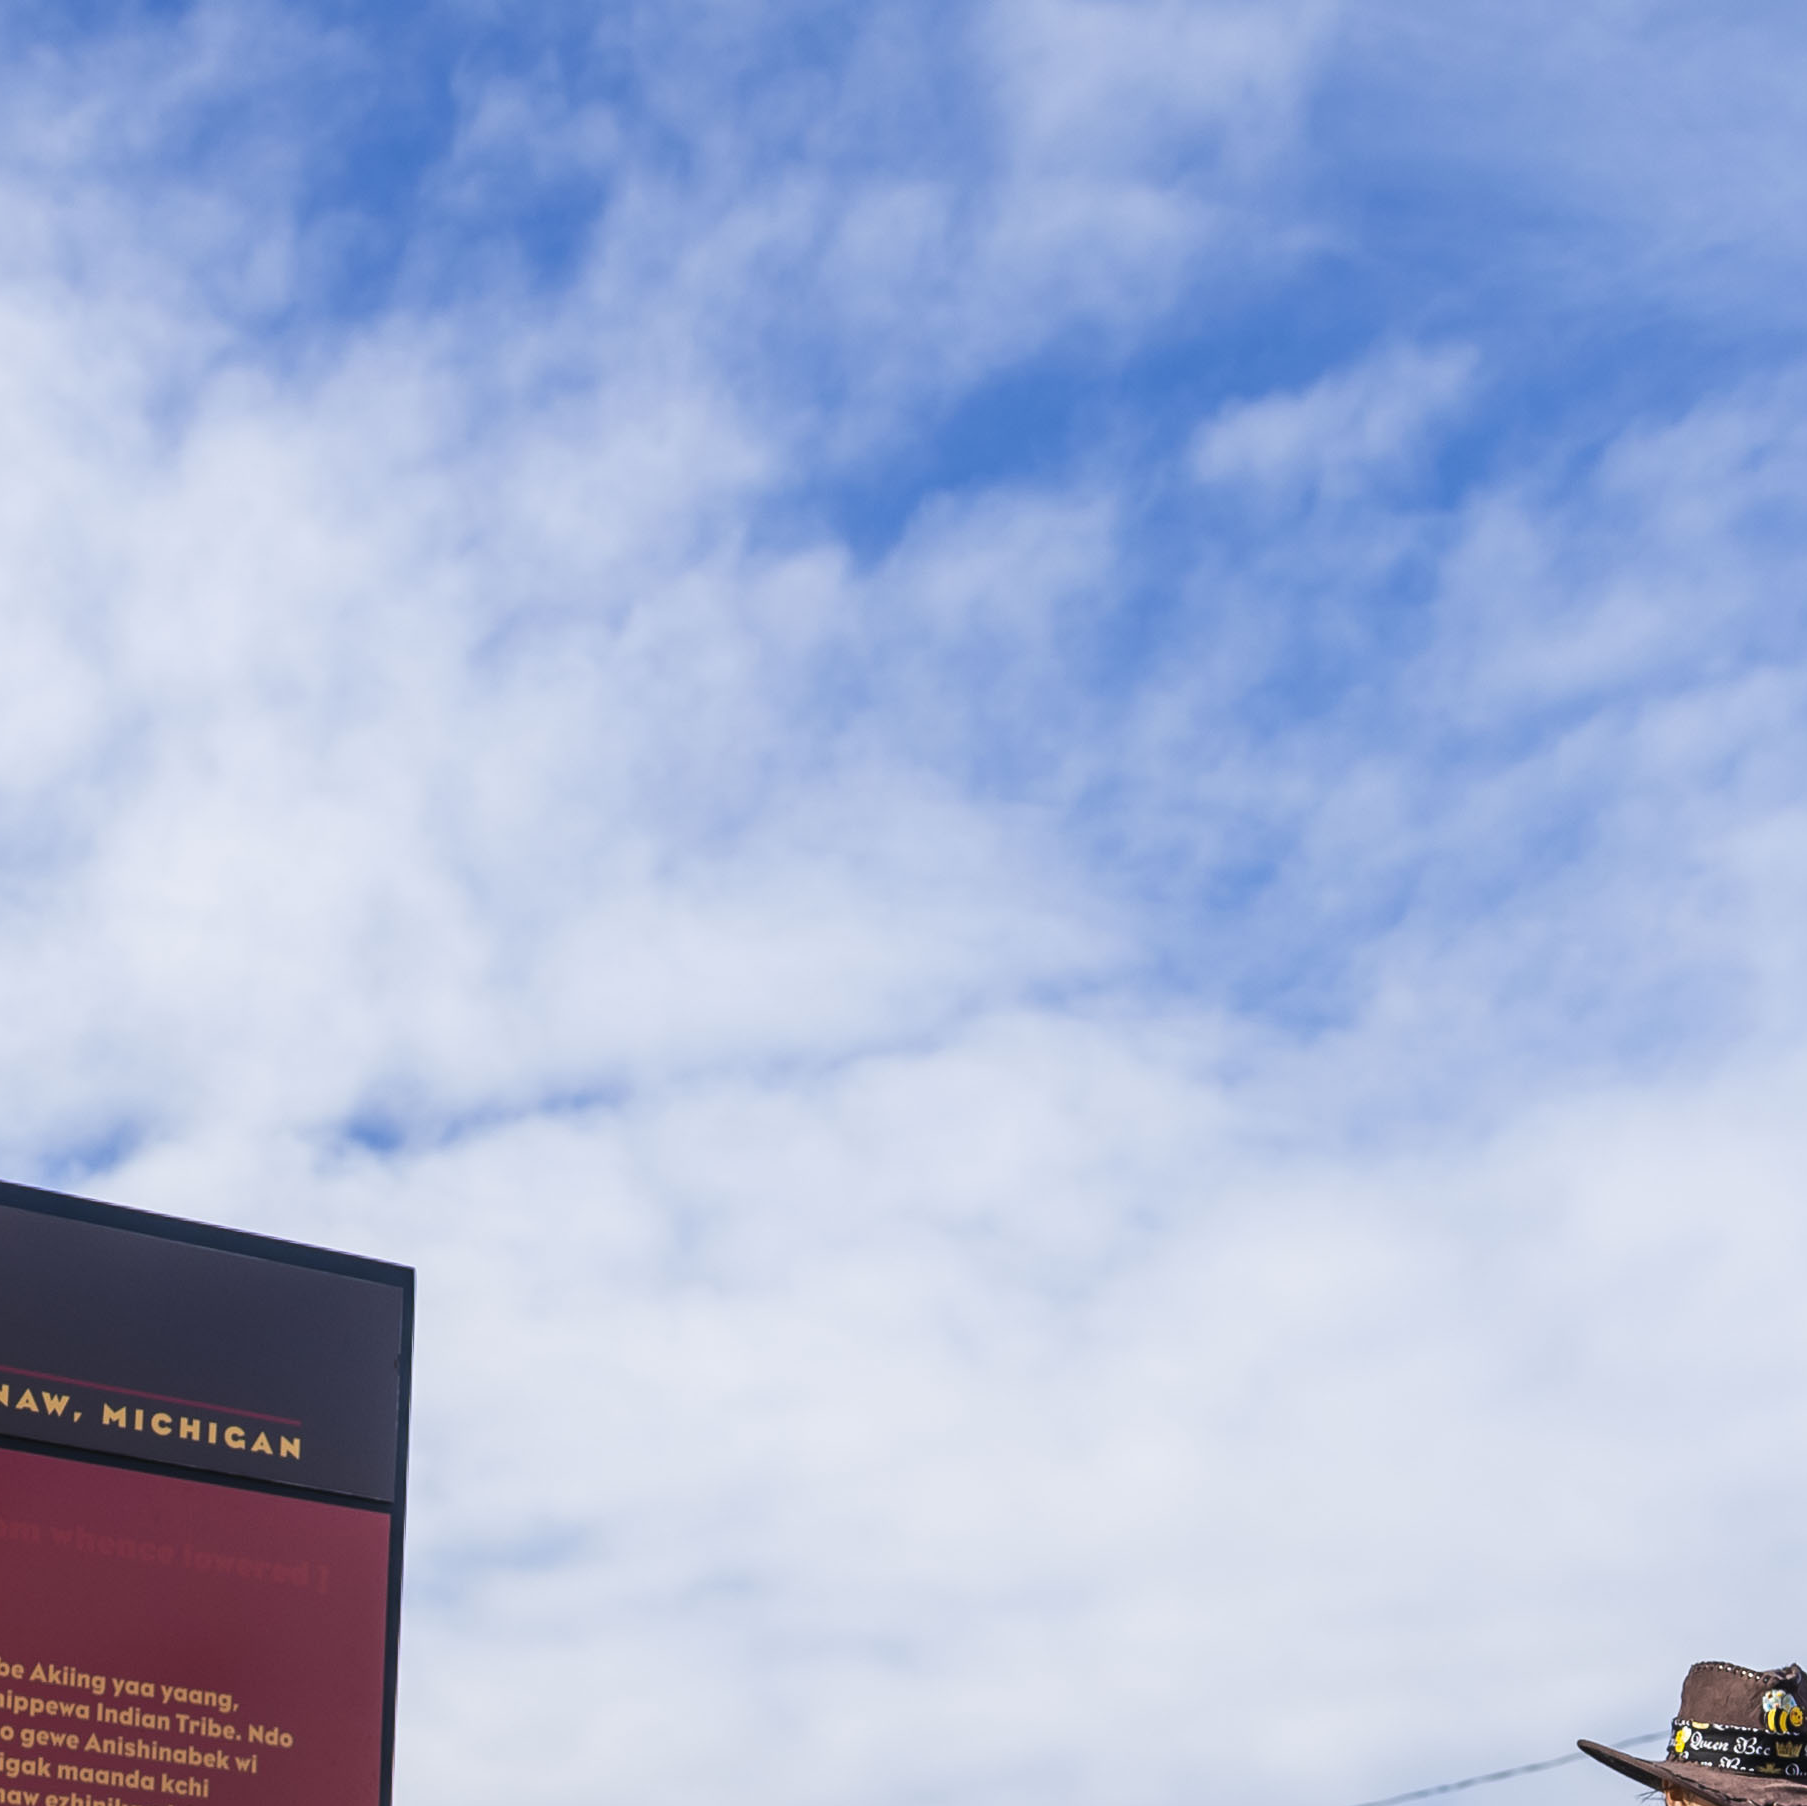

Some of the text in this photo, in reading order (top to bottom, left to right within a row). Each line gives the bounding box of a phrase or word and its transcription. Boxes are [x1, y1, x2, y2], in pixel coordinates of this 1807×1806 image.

[102, 1404, 301, 1458] MICHIGAN
[28, 1662, 107, 1696] Akiing
[111, 1677, 155, 1698] yaa
[160, 1684, 239, 1714] yaang,
[96, 1702, 171, 1731] Indian
[175, 1713, 242, 1741] Tribe.
[248, 1723, 294, 1749] Ndo
[1689, 1730, 1771, 1756] Queen Bee
[20, 1727, 80, 1750] gewe
[83, 1732, 230, 1771] Anishinabek
[234, 1754, 258, 1774] wi
[57, 1764, 155, 1791] maanda
[161, 1773, 209, 1798] kchi
